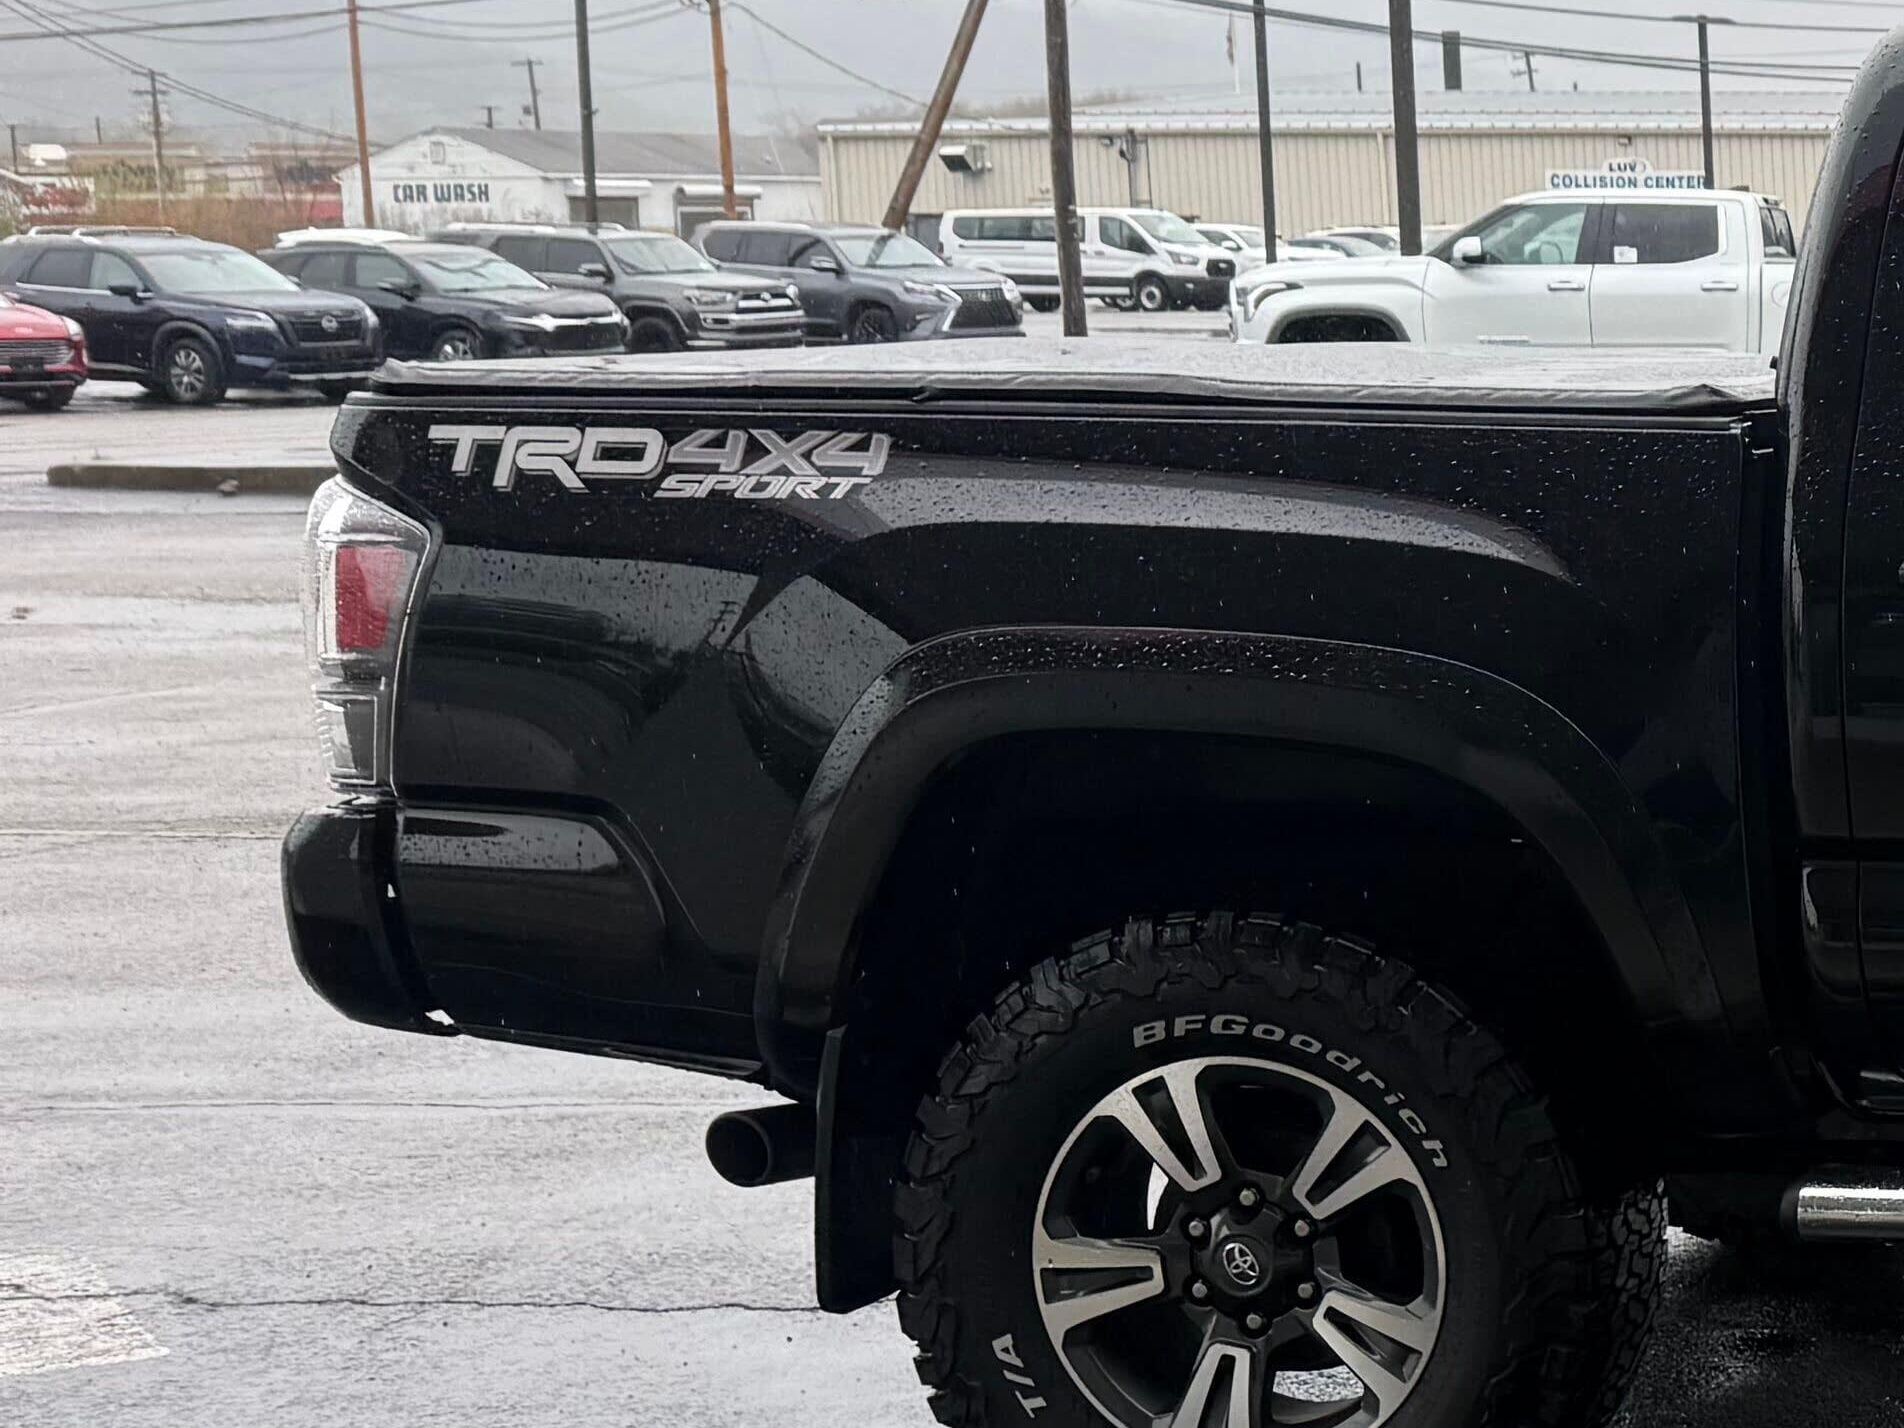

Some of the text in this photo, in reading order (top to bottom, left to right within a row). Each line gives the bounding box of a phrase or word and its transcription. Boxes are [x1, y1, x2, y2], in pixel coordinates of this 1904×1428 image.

[392, 183, 490, 203] CAR WASH
[1550, 174, 1638, 189] COLLISION
[427, 424, 669, 493] TRD
[653, 475, 872, 499] SPORT
[1132, 1013, 1450, 1169] BFGoodrich
[990, 1332, 1049, 1419] T/A
